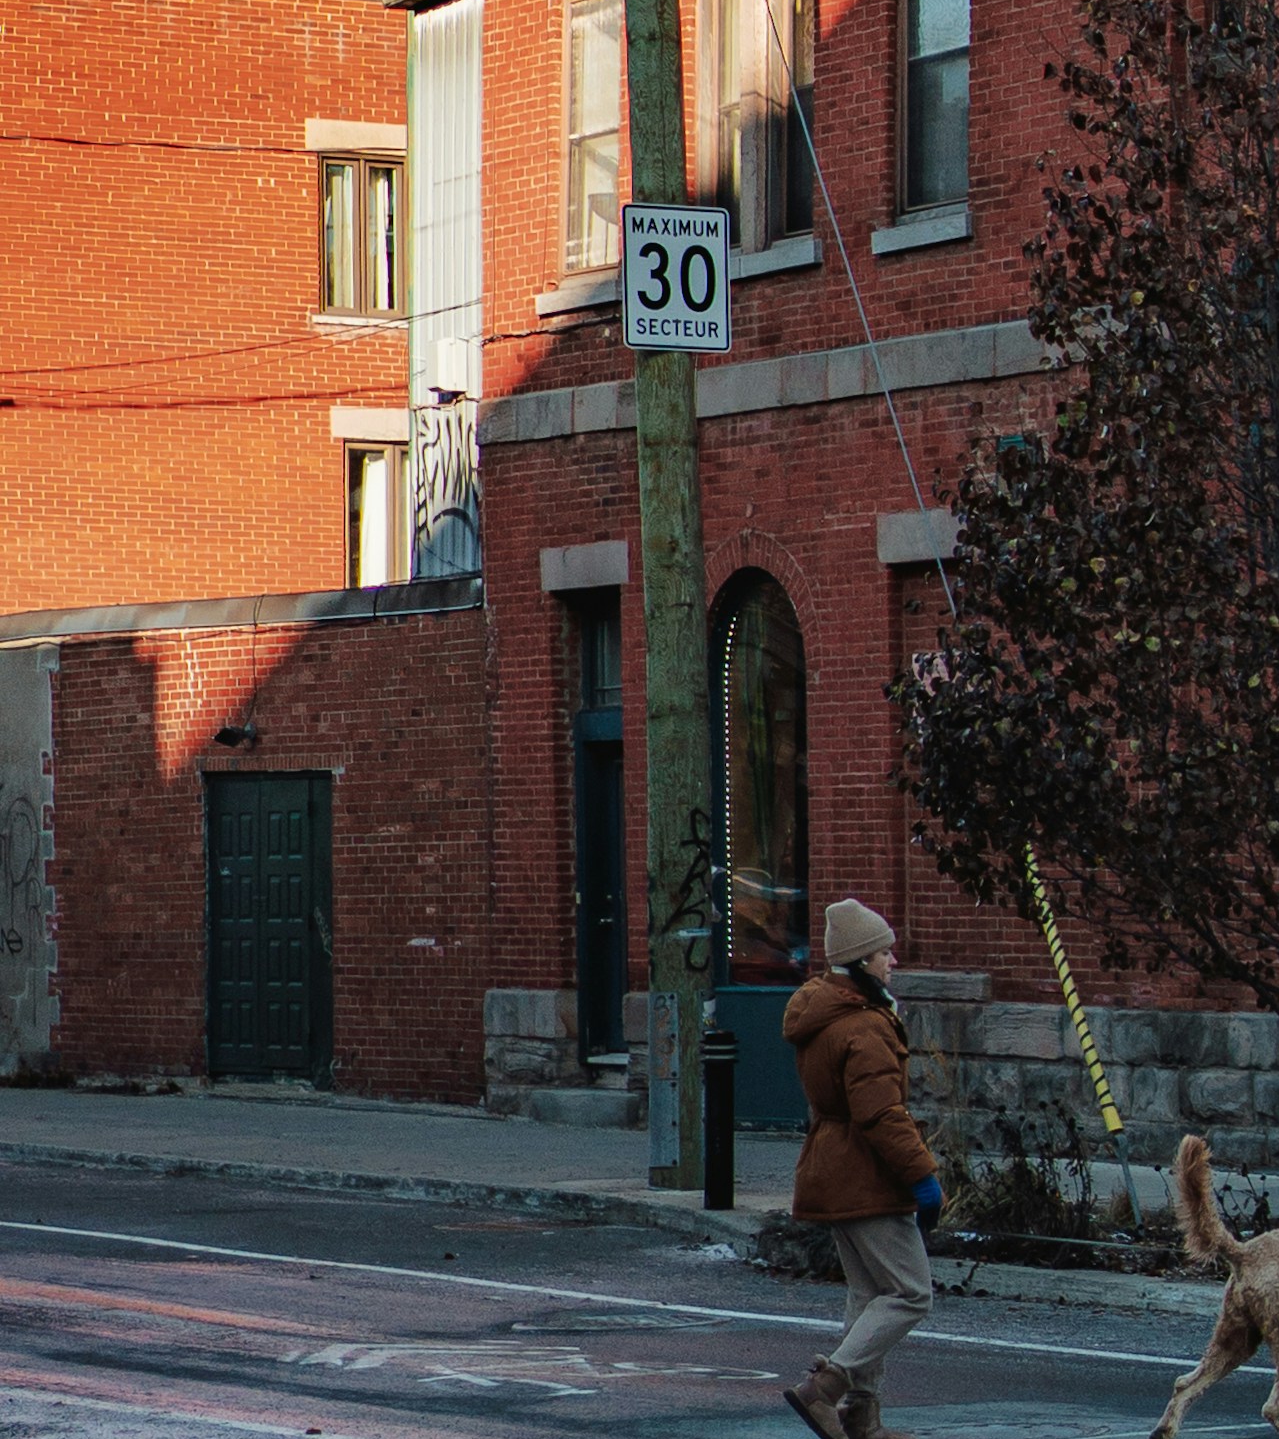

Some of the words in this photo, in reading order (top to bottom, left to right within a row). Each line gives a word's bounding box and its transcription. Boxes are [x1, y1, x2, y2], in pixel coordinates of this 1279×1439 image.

[631, 216, 719, 238] MAXIMUM
[637, 242, 716, 312] 30
[636, 317, 719, 338] SECTEUR
